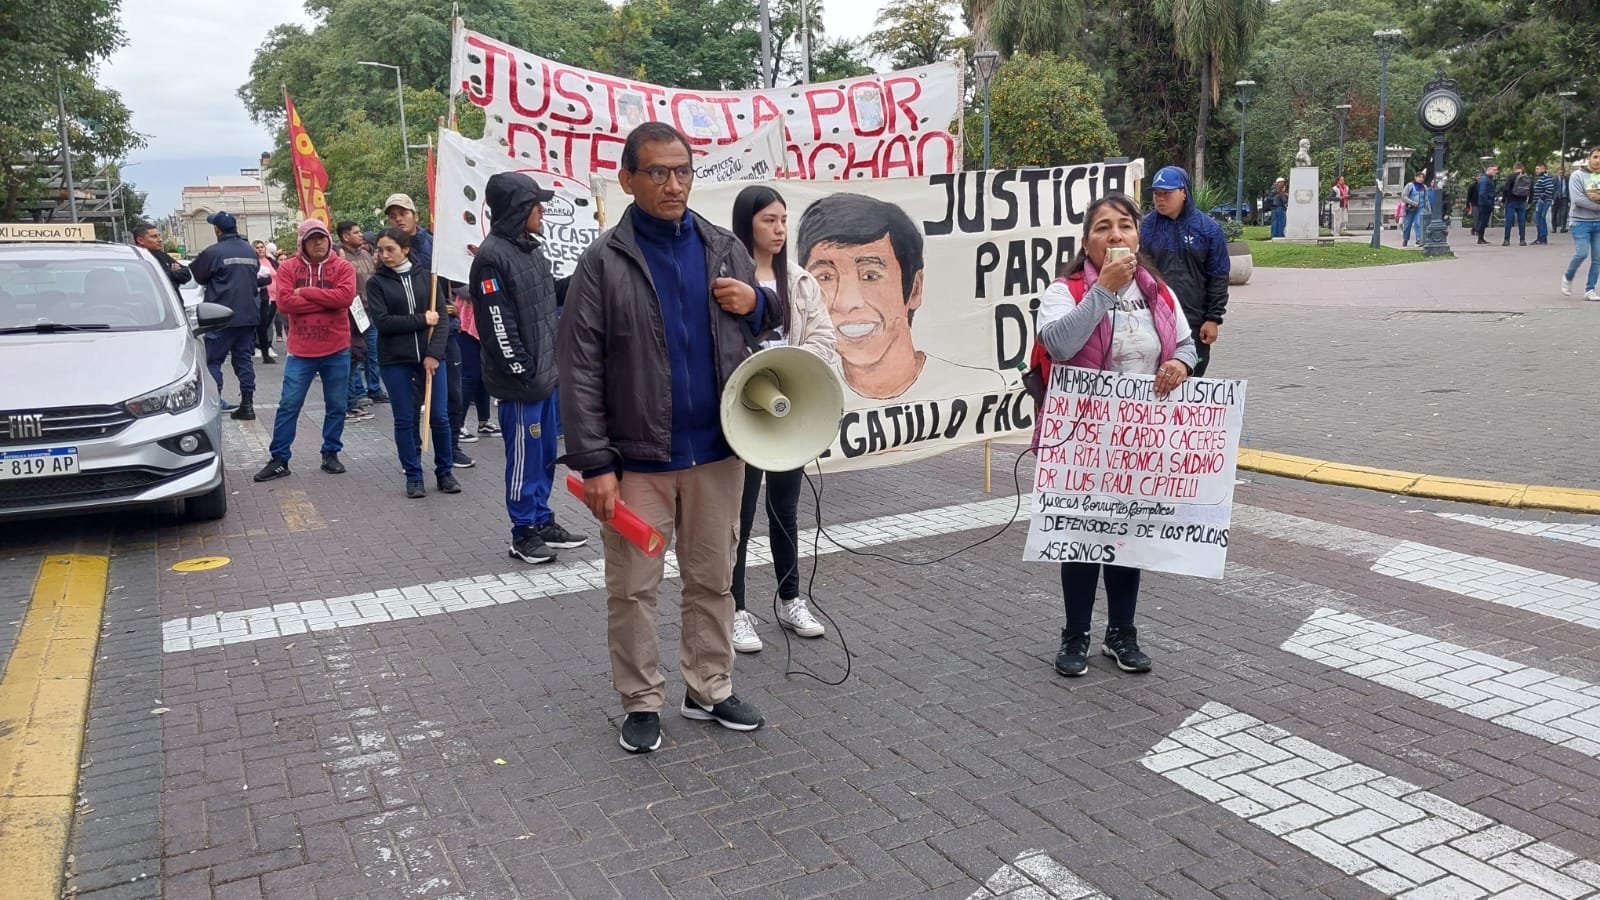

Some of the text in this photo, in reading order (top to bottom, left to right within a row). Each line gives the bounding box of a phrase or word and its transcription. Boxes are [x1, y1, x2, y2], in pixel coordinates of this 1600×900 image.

[806, 76, 921, 141] POR
[64, 226, 82, 238] 071
[488, 304, 516, 359] AMIGOS
[1117, 400, 1167, 426] ROSALES
[8, 414, 43, 439] FIAT
[12, 458, 45, 475] 819
[53, 456, 73, 472] AP
[1073, 445, 1100, 468] RITA
[1065, 468, 1097, 492] LUIS
[1039, 515, 1129, 536] DEFENSORES
[1134, 523, 1155, 538] DE
[1160, 523, 1185, 540] LOS
[1038, 541, 1116, 562] ASESINOS
